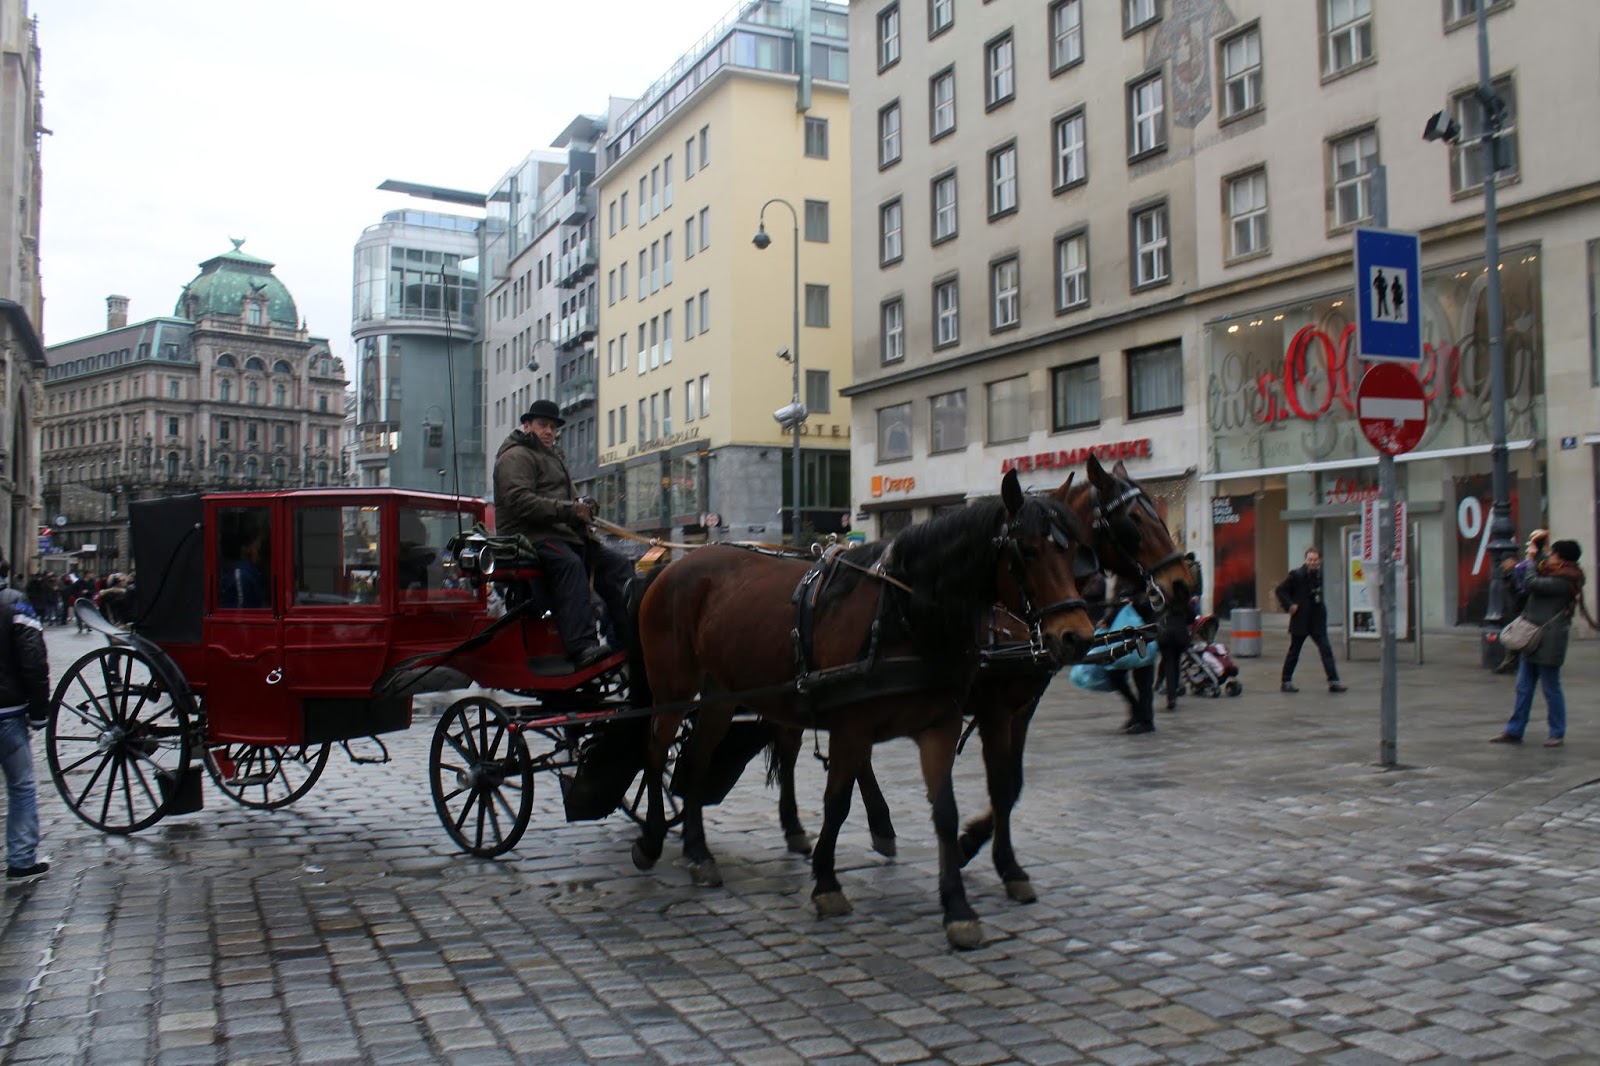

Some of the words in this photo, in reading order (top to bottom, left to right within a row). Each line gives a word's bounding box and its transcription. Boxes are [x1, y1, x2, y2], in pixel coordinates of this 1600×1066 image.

[1001, 455, 1032, 474] ALTE
[1033, 438, 1152, 471] FELDAPOTHEKE
[882, 475, 916, 494] Orange
